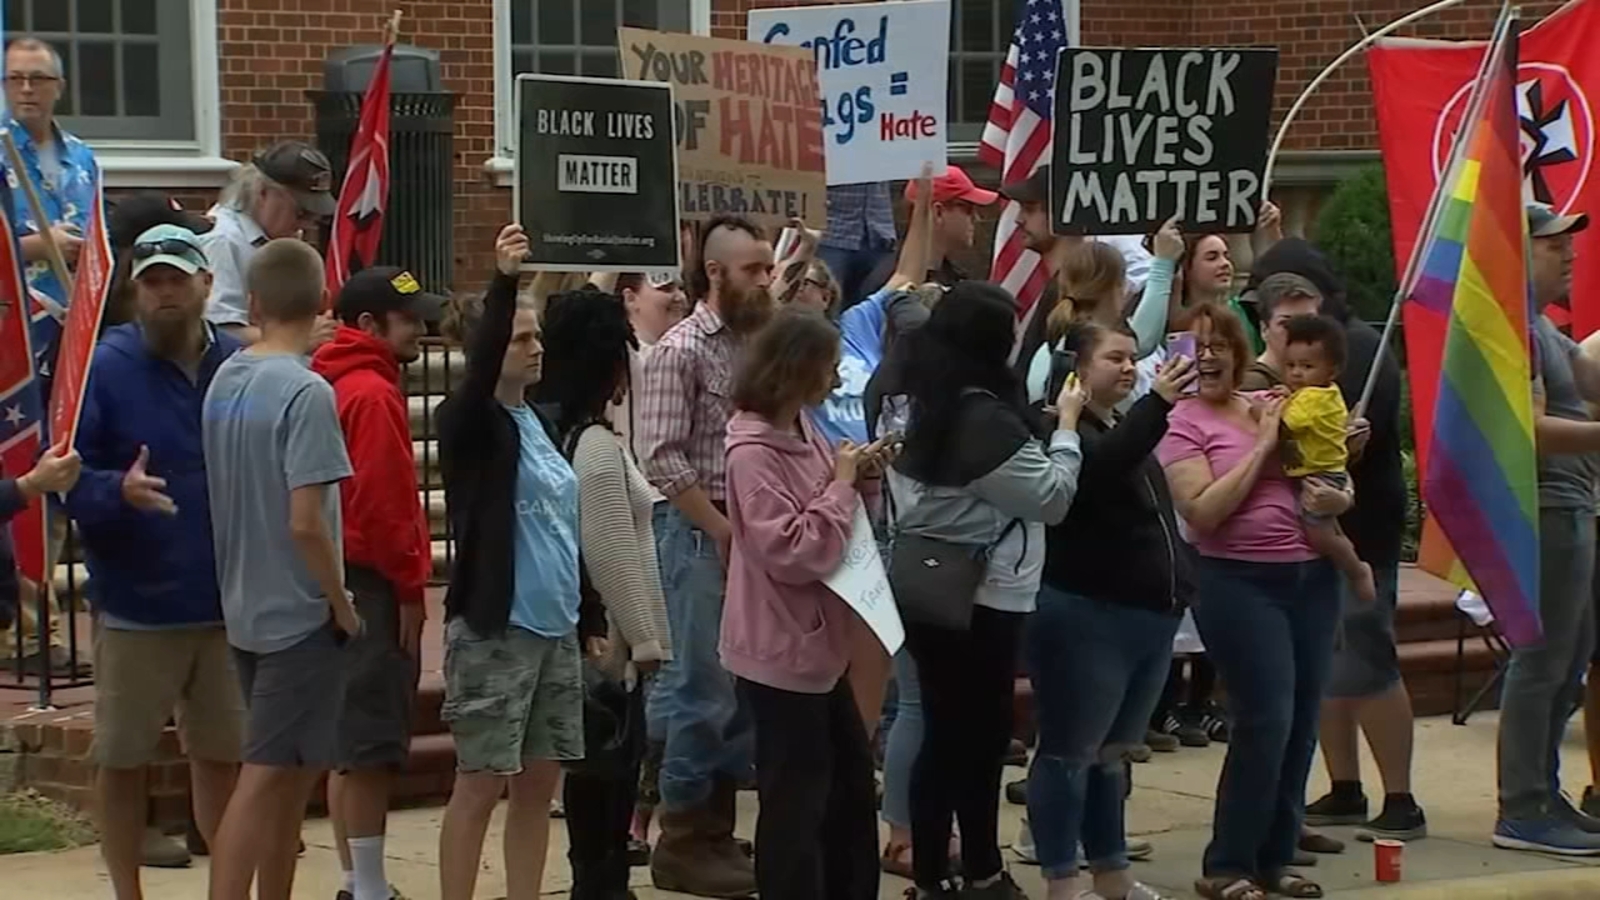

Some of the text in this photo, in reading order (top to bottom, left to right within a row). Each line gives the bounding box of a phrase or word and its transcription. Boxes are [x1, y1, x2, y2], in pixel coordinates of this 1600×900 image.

[631, 43, 709, 85] YOUR
[763, 15, 888, 70] nfed
[1070, 51, 1241, 117] BLACK
[537, 109, 654, 139] BLACK LIVES
[719, 97, 826, 172] HATE
[820, 86, 875, 144] gs
[880, 110, 937, 141] Hate
[1069, 112, 1214, 166] LIVES
[565, 160, 632, 188] MATTER
[678, 181, 807, 220] LEBRATE!
[1061, 169, 1259, 227] MATTER
